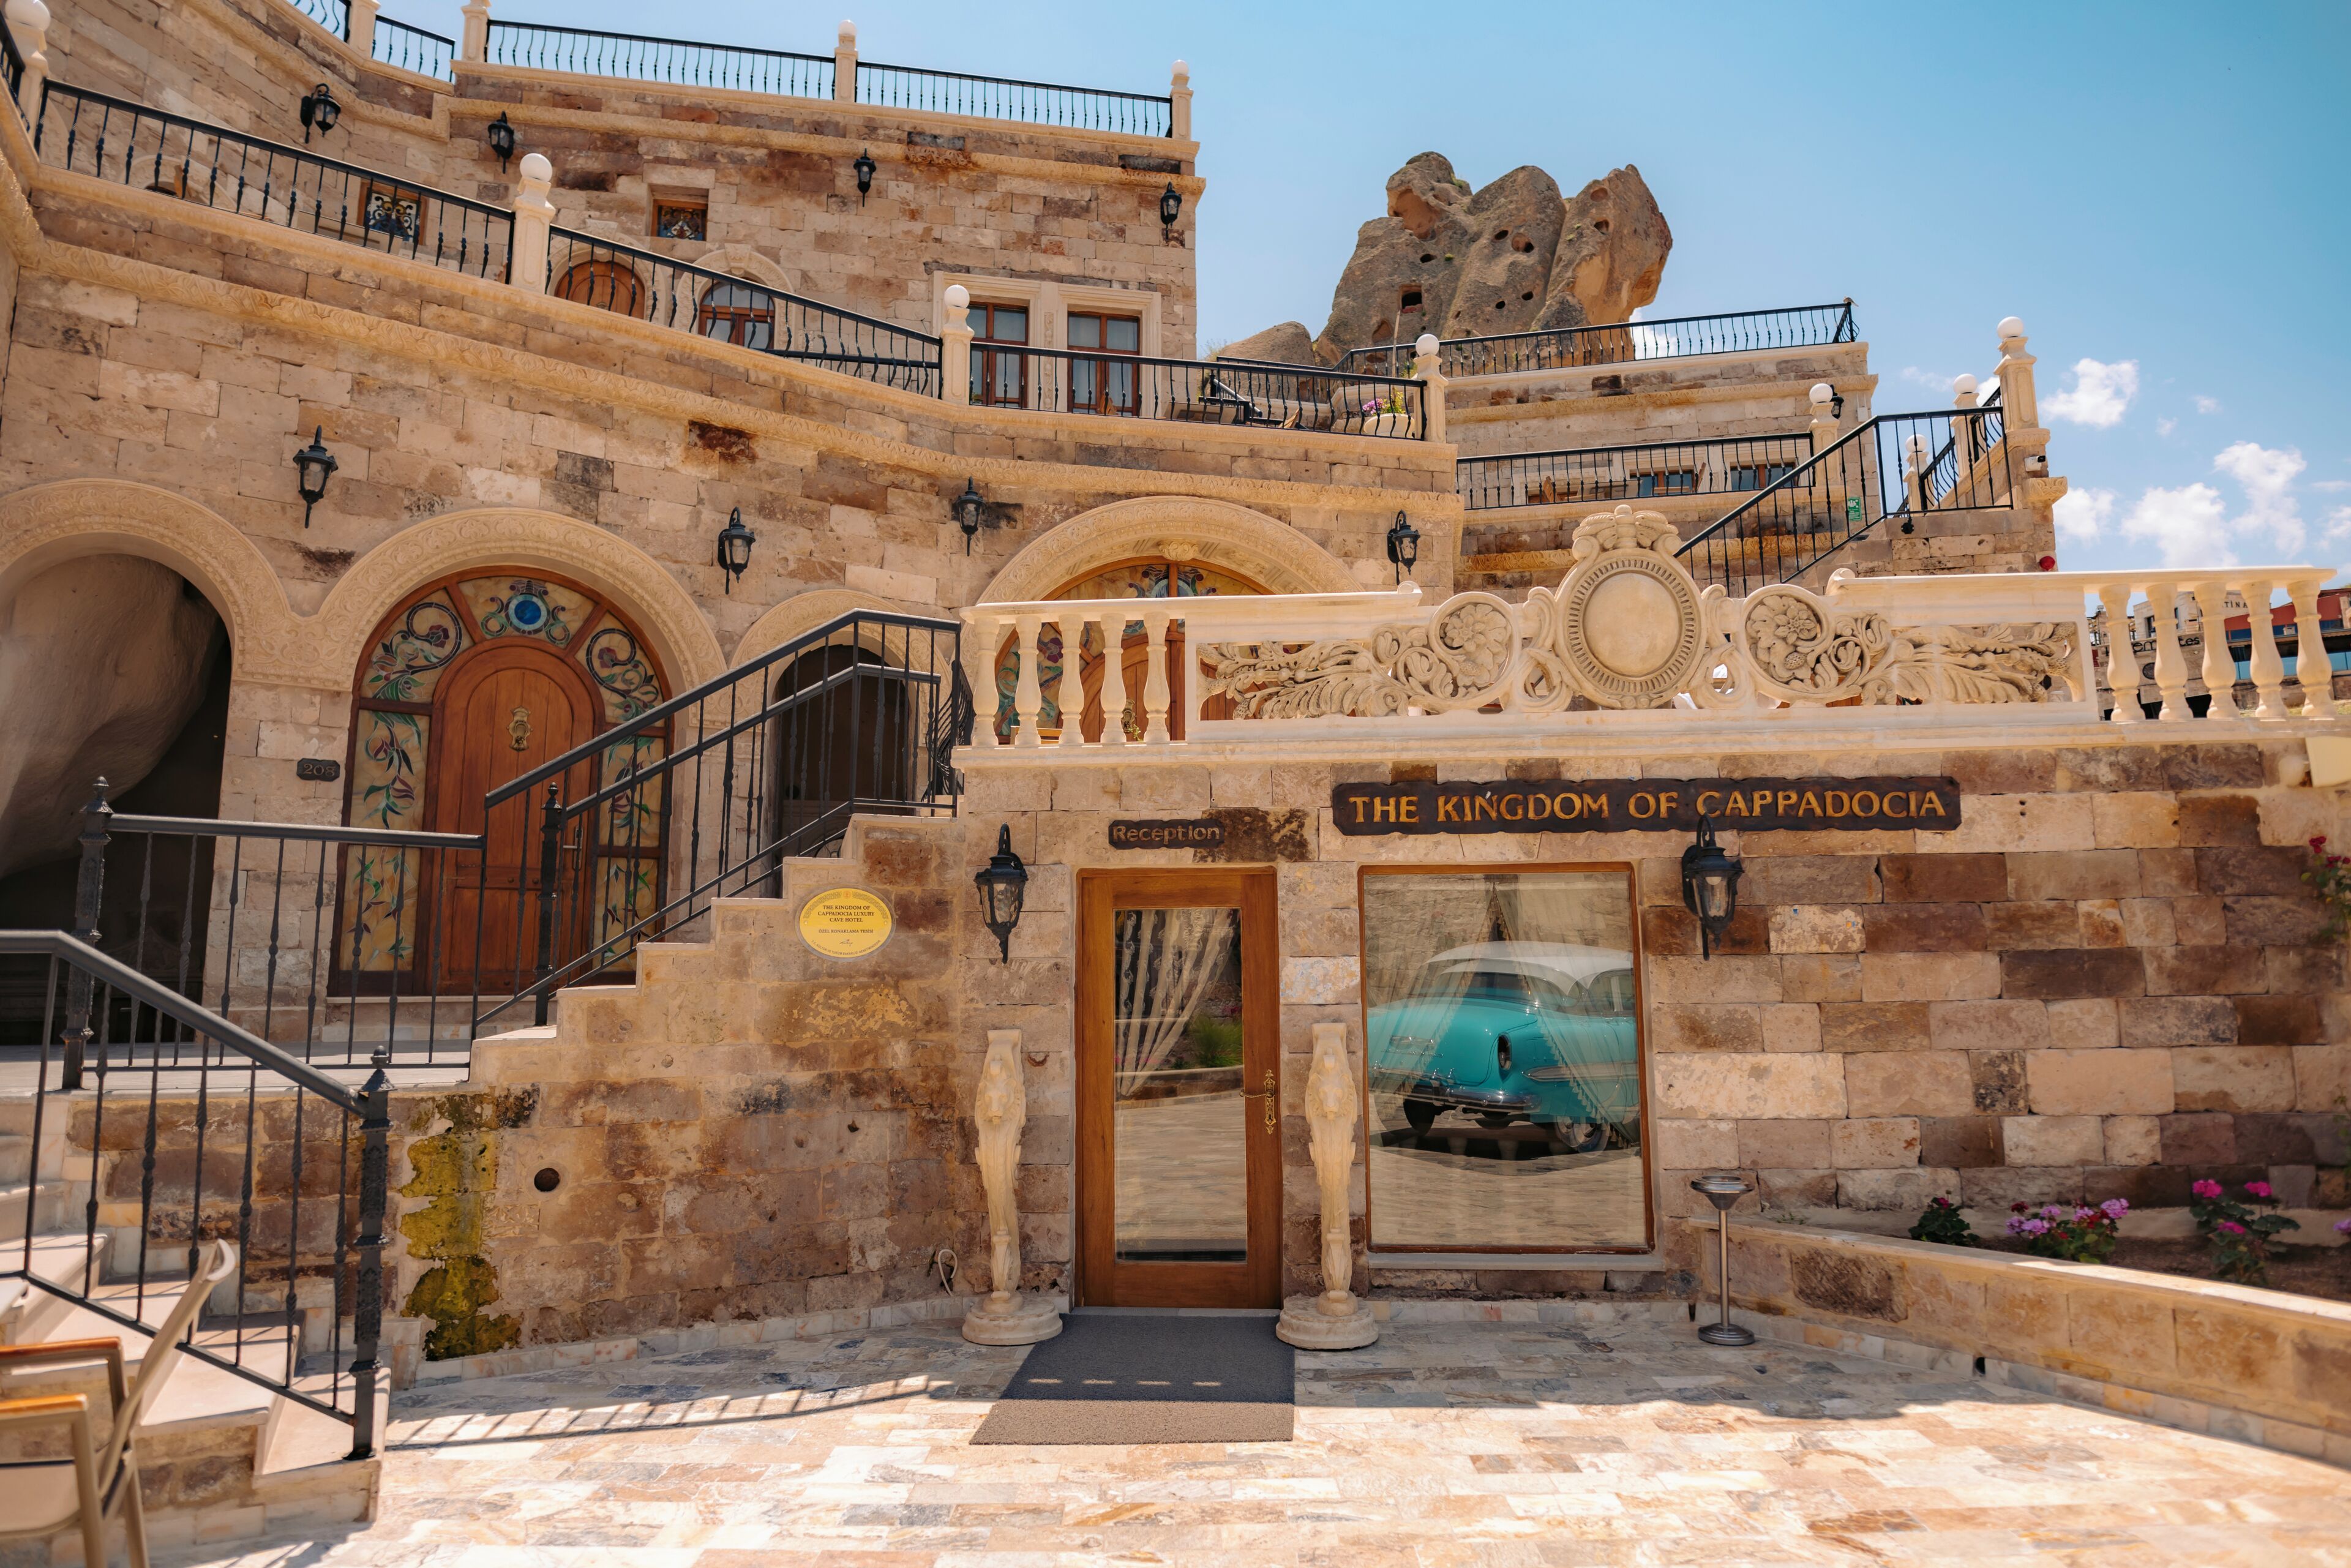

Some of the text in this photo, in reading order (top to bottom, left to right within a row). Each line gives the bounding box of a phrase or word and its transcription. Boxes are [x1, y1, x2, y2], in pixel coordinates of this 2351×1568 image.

[303, 763, 336, 776] 208
[1349, 790, 1946, 823] THE KINGDOM OF CAPPADOCIA
[1112, 825, 1220, 844] Reception
